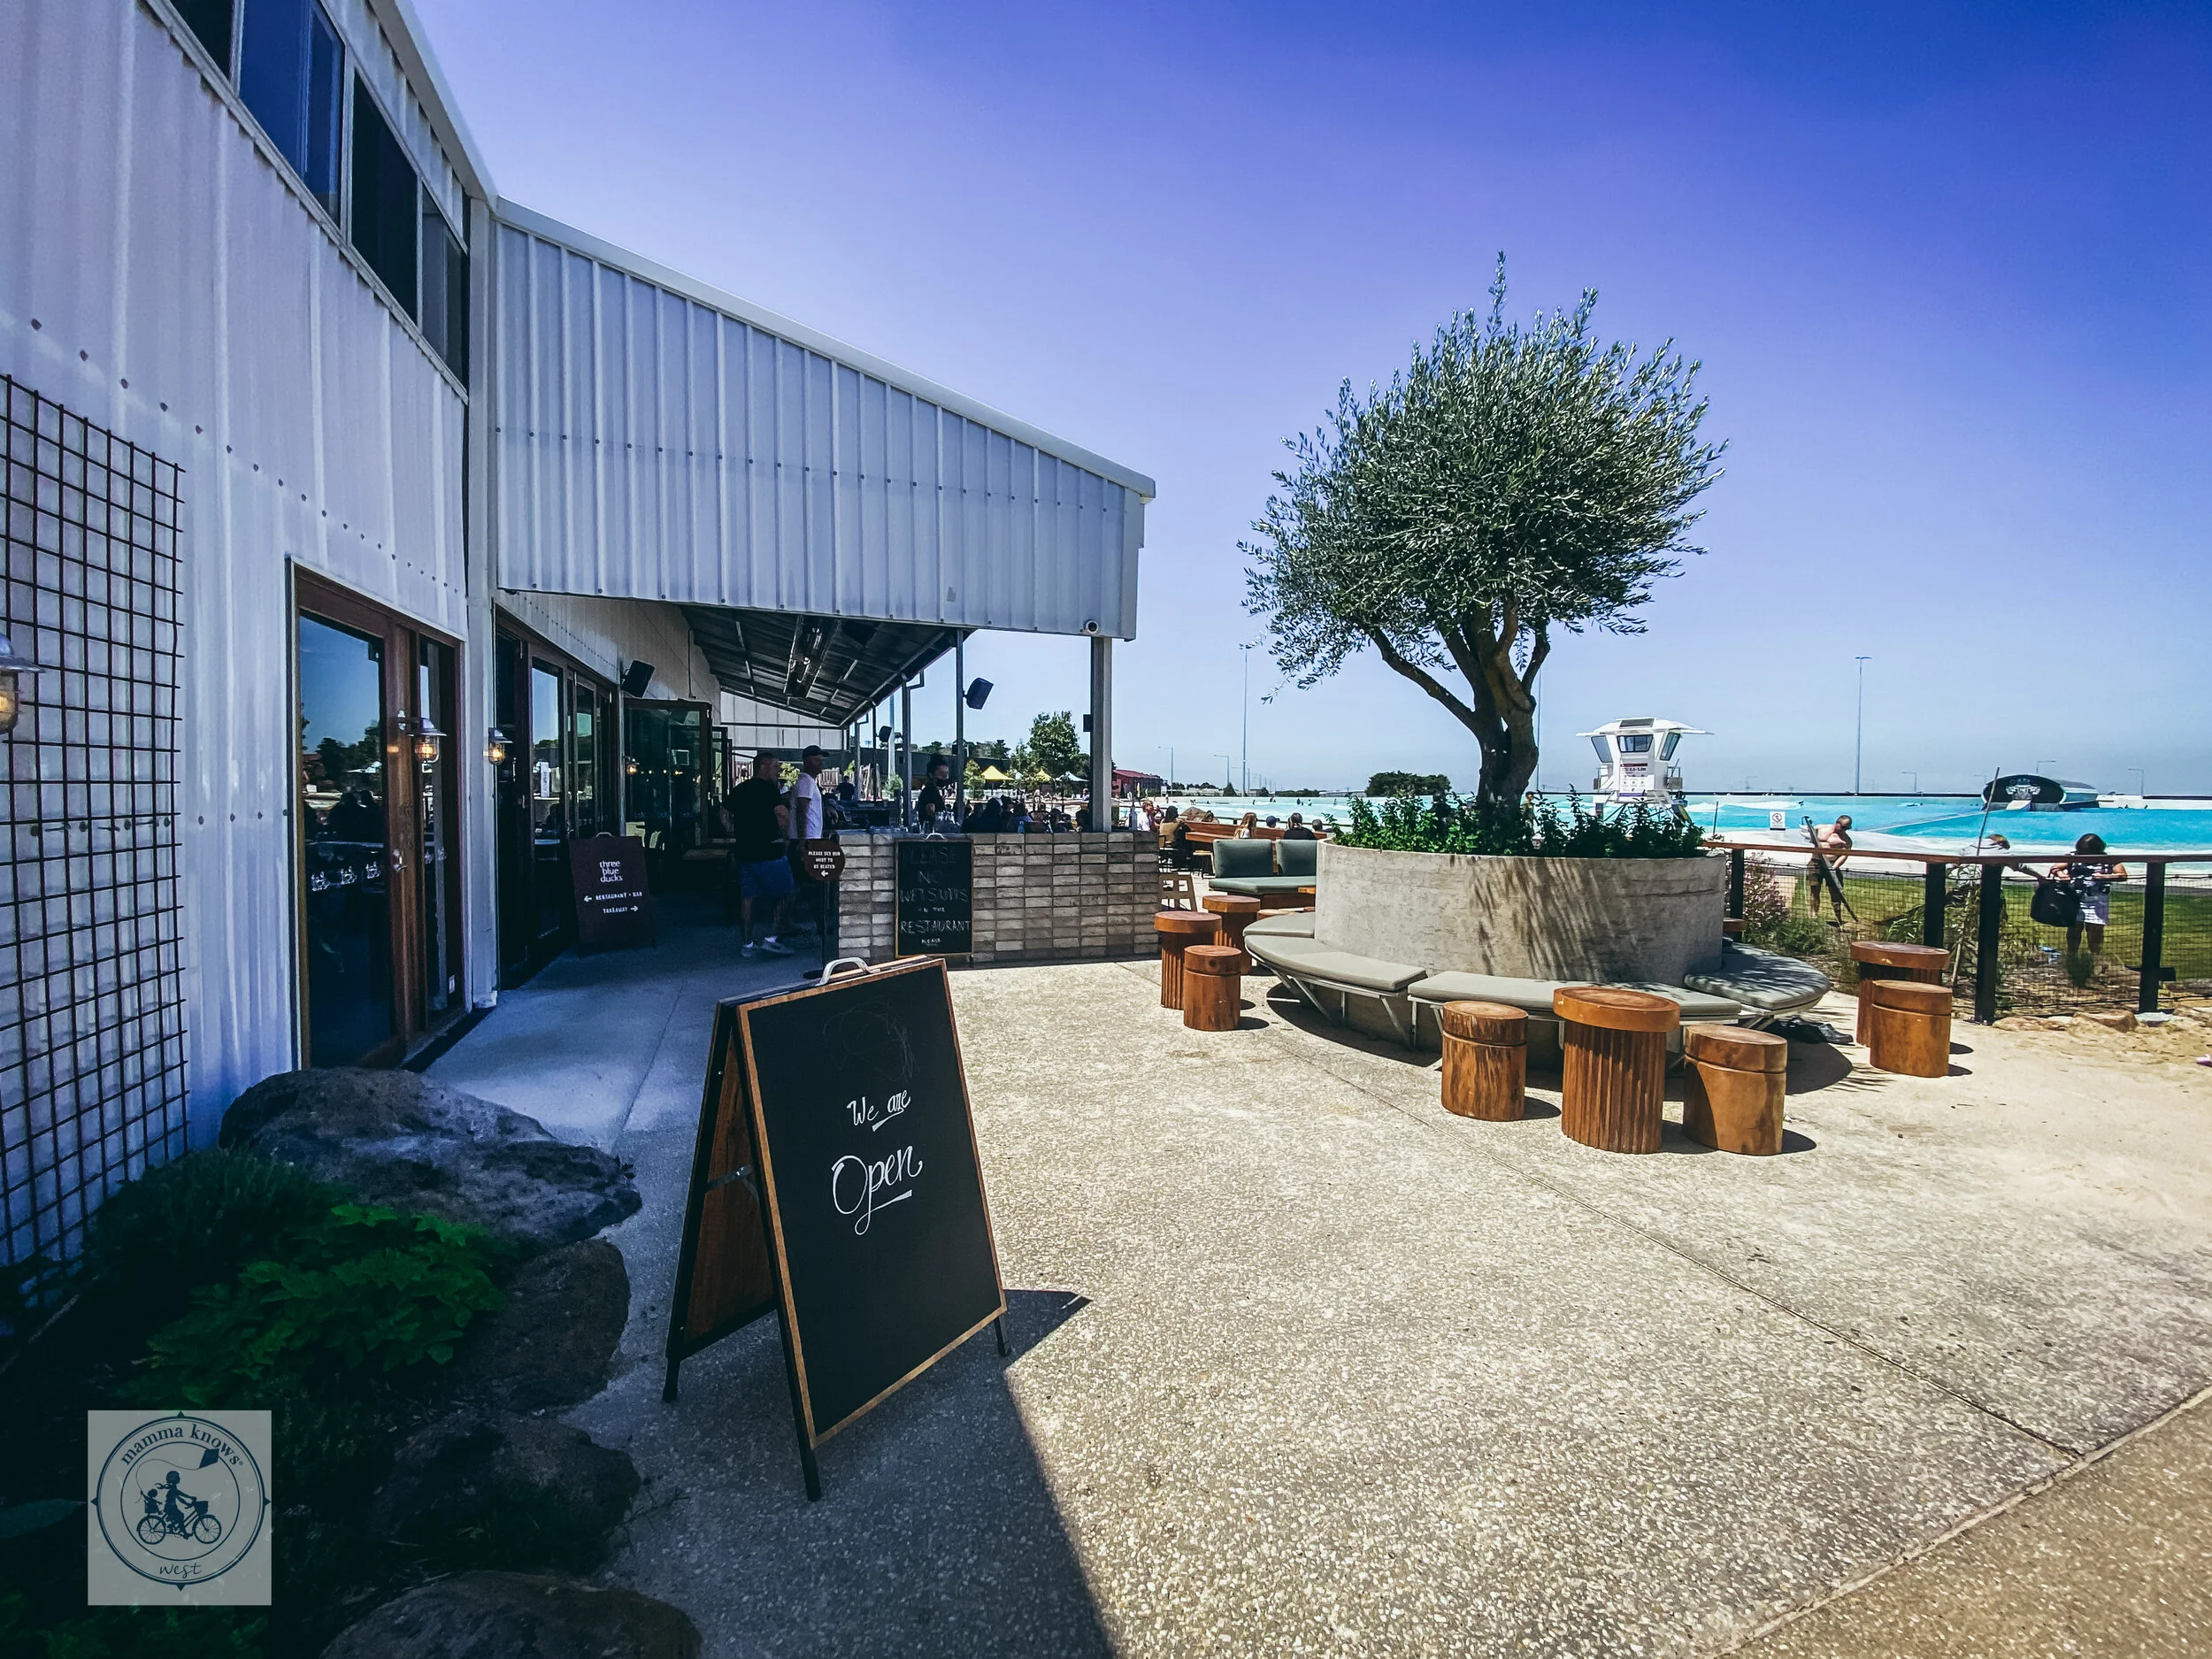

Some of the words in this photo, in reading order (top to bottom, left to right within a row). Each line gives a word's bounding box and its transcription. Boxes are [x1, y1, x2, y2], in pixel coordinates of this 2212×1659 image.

[600, 874, 623, 883] ducks
[918, 870, 942, 884] NO
[595, 892, 627, 901] RESTAURANT
[899, 887, 970, 902] WETSUITS
[901, 919, 971, 934] RESTAURANT
[847, 1095, 879, 1126] We
[831, 1145, 924, 1236] Open
